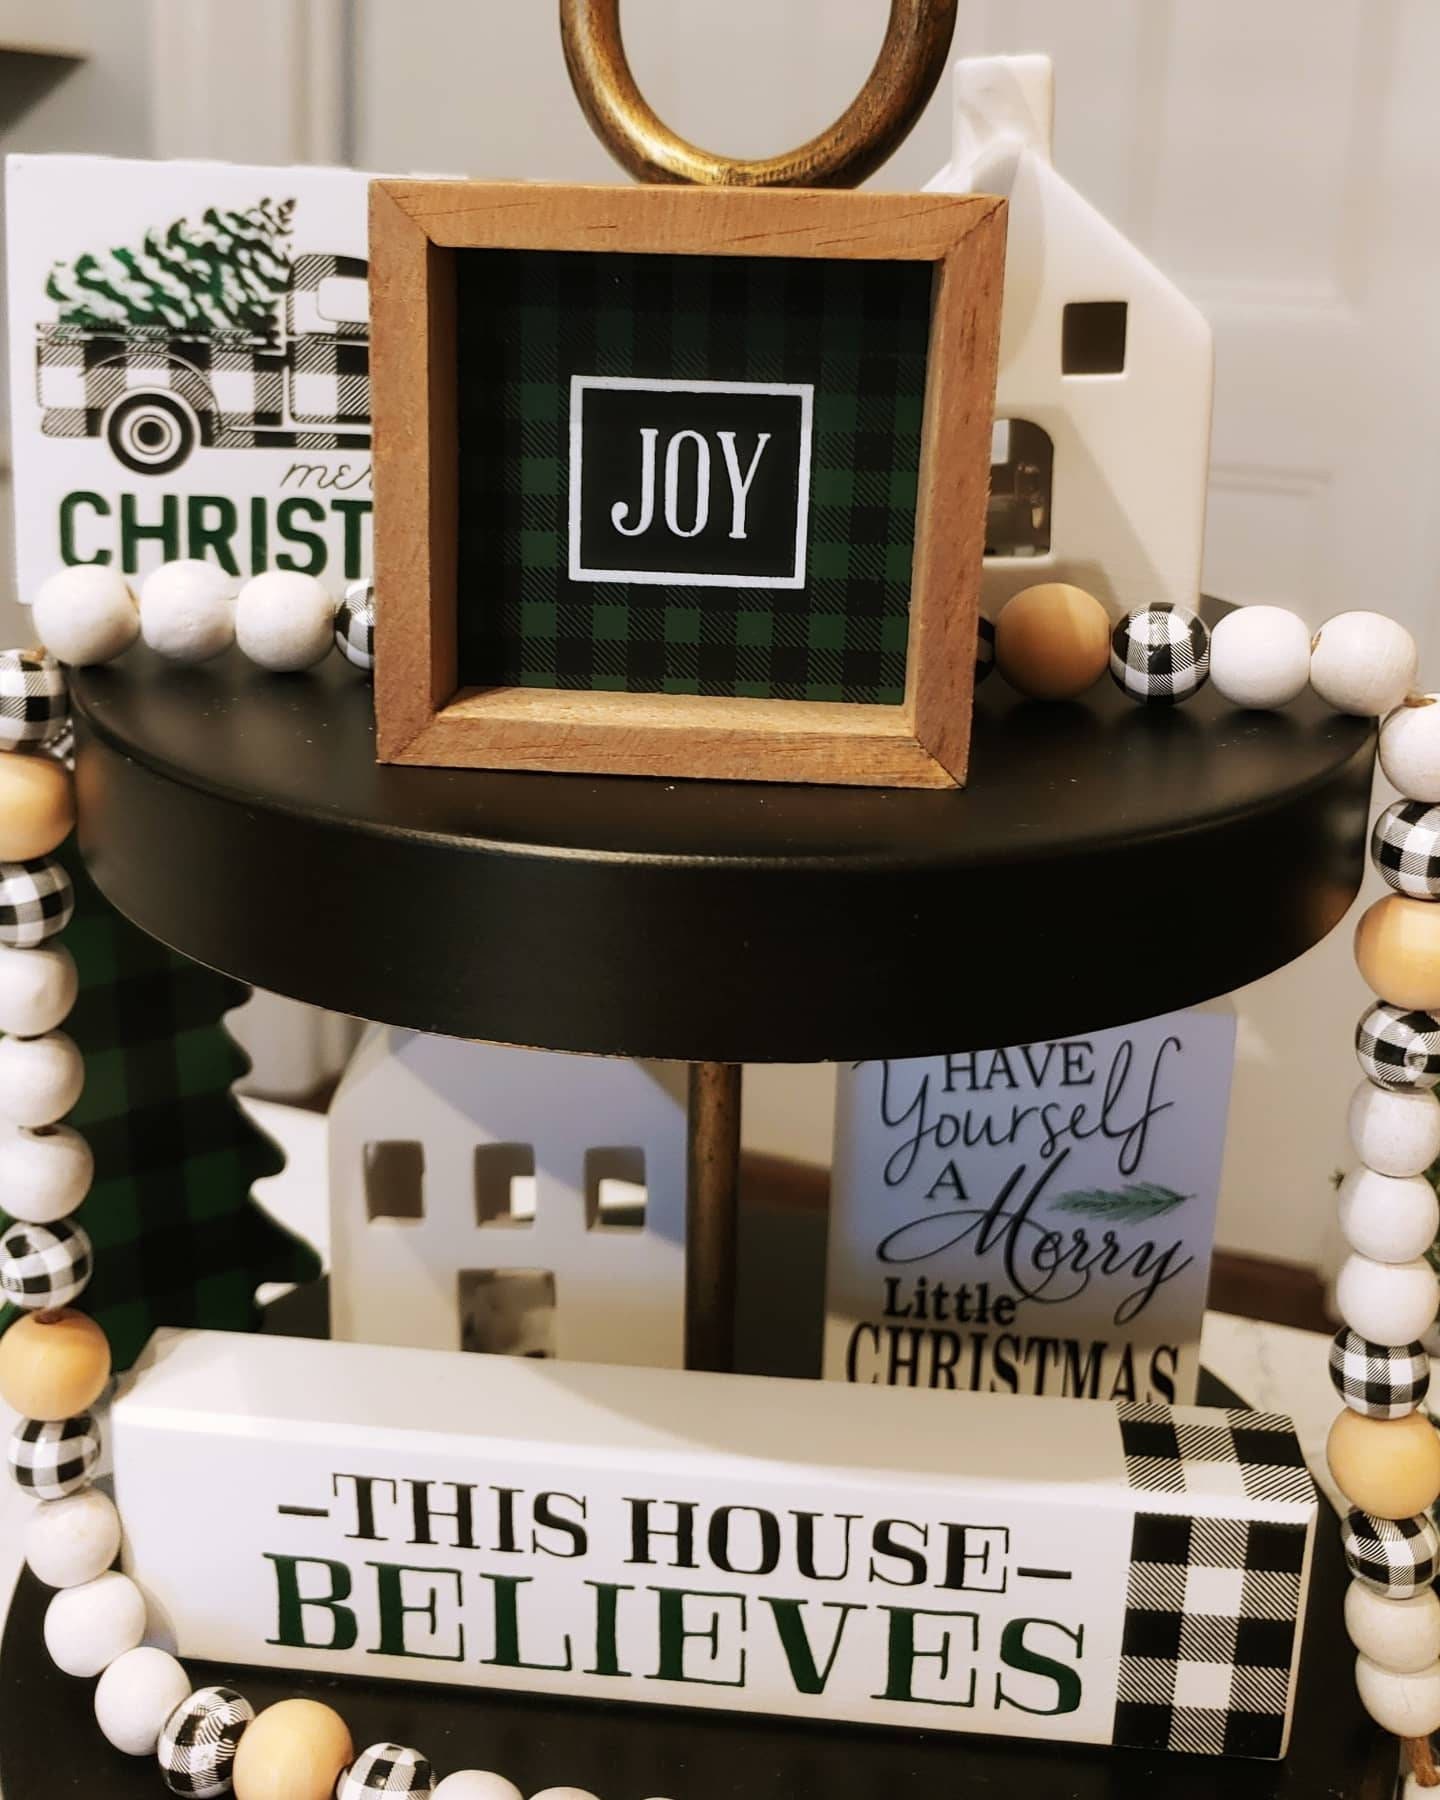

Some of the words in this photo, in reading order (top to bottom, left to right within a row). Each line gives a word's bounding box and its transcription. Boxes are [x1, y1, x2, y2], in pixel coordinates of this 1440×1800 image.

[611, 428, 771, 538] JOY
[59, 490, 373, 579] CHRIST
[852, 1036, 1182, 1186] Yourself
[940, 1041, 1096, 1092] HAVE
[924, 1159, 969, 1200] A
[876, 1147, 1194, 1326] Merry
[883, 1275, 1017, 1326] Little
[845, 1321, 1179, 1404] CHRISTMAS
[262, 1552, 1084, 1716] BELIEVES
